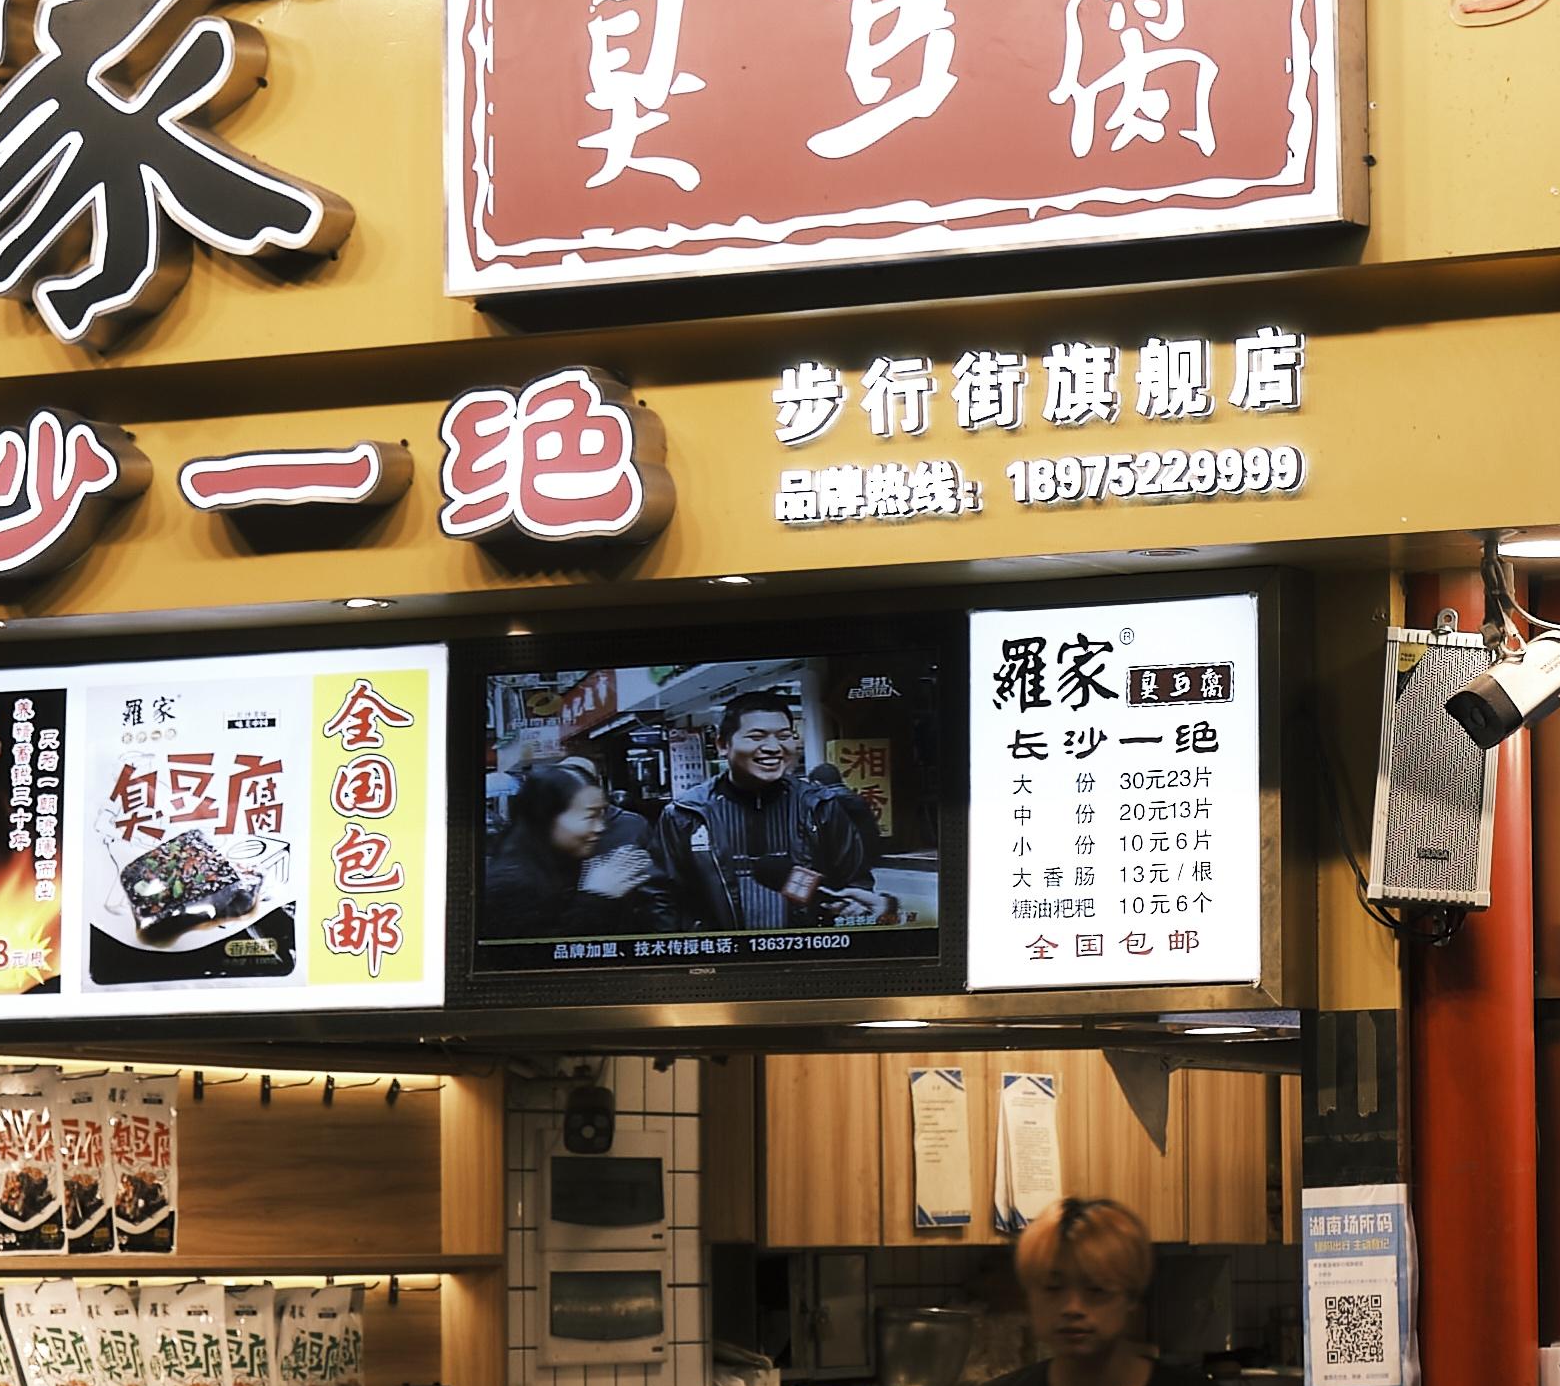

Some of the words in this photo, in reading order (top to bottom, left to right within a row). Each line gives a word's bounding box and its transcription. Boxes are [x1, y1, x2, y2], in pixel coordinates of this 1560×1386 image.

[771, 326, 1307, 447] 步行街旗舰店
[1006, 445, 1306, 508] 18975229999
[992, 633, 1120, 713] 羅家
[1139, 667, 1224, 701] 臭豆腐
[122, 696, 176, 728] 羅家
[1007, 721, 1219, 761] 长沙一绝
[1119, 766, 1213, 791] 30元23片
[109, 752, 284, 842] 臭豆腐
[1119, 797, 1213, 822] 20元13片
[323, 678, 415, 979] 全国包邮
[1012, 866, 1096, 888] 大香肠
[1011, 898, 1096, 920] 糖油粑粑
[748, 934, 852, 953] 13637316020
[1025, 929, 1200, 961] 全国包邮
[1309, 1212, 1393, 1237] 湖南场所码
